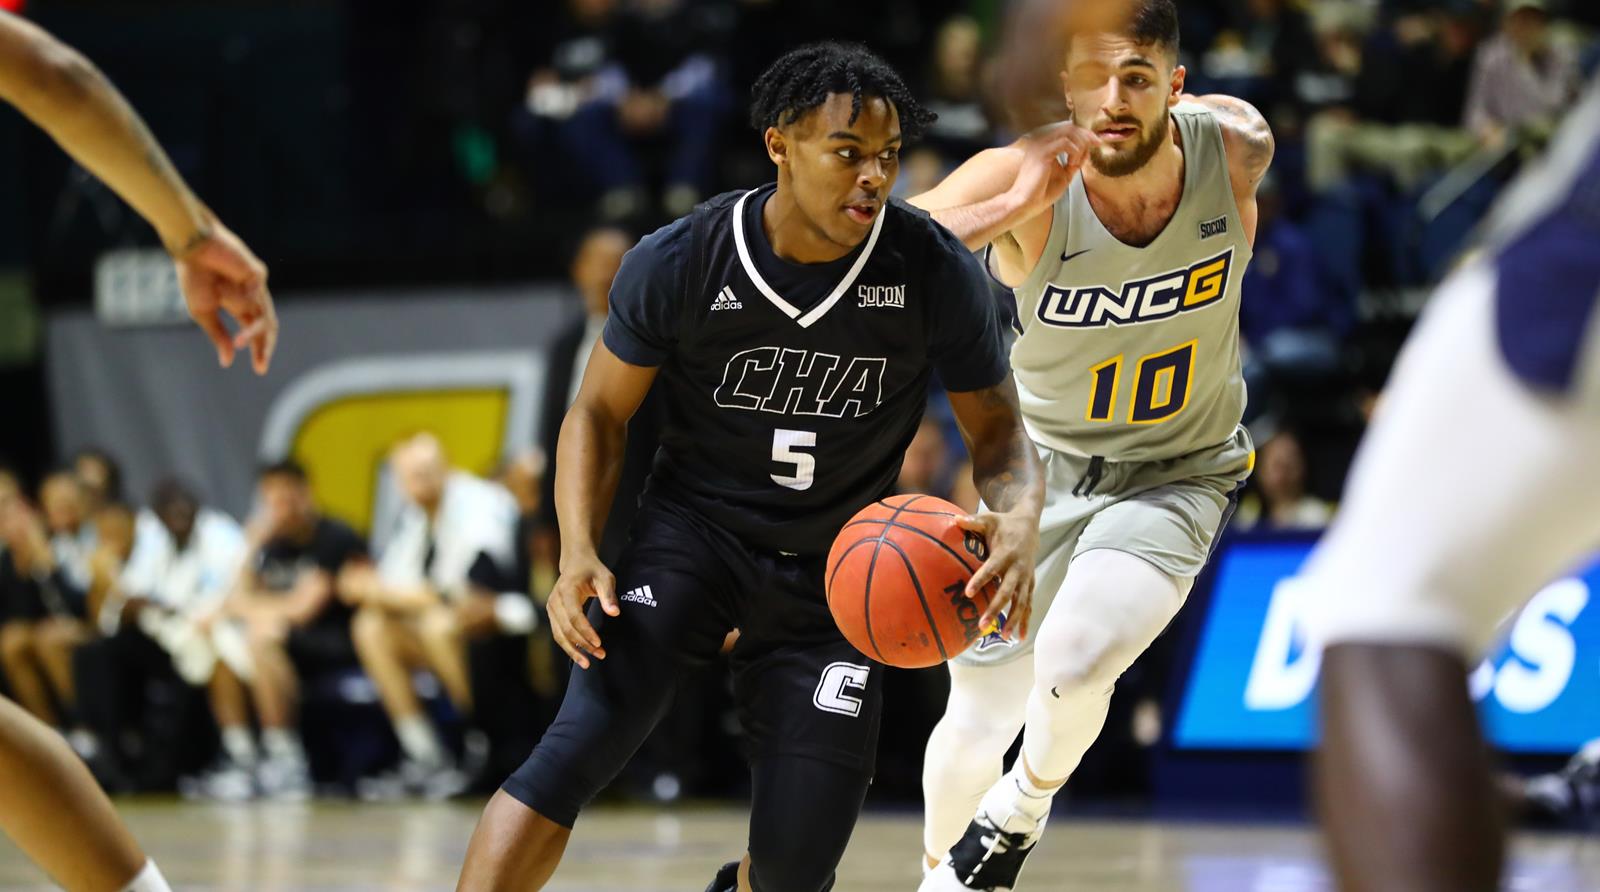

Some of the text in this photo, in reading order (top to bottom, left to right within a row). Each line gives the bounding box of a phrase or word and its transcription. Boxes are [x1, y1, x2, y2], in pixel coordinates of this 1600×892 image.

[1200, 216, 1227, 239] SOCON
[710, 300, 743, 311] adidas
[858, 284, 906, 308] SOCON
[1035, 245, 1235, 329] UNCG
[713, 346, 887, 418] CHA
[1085, 338, 1199, 425] 10
[769, 428, 817, 491] 5
[620, 593, 658, 608] adidas
[812, 660, 871, 718] C
